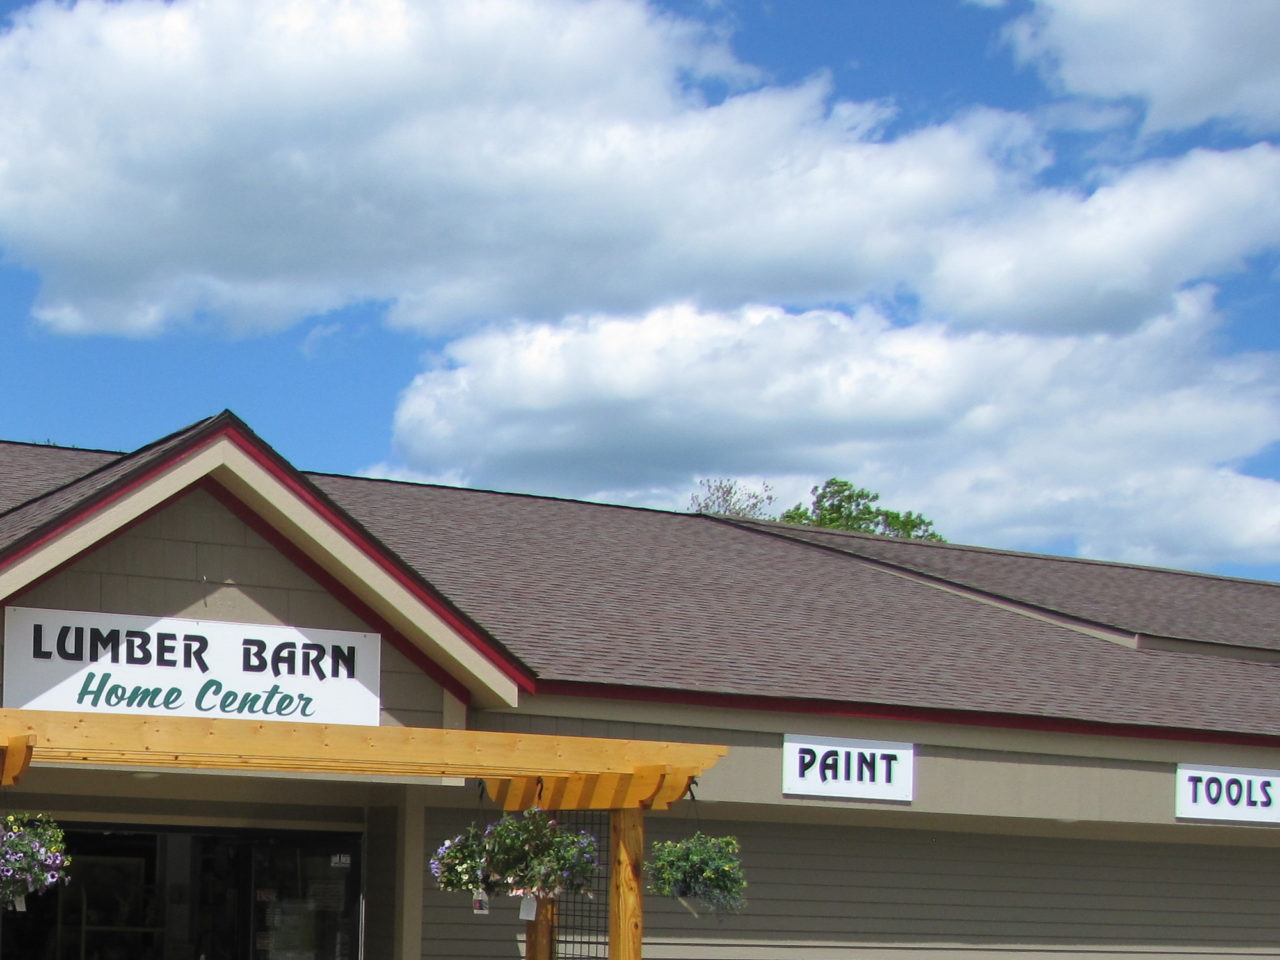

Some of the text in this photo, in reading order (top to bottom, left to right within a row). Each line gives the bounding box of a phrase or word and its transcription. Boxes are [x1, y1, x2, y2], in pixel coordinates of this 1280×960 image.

[32, 623, 356, 682] LUMBER BARN
[76, 671, 316, 718] Home Center
[797, 747, 898, 785] PAINT
[1187, 775, 1273, 808] TOOLS
